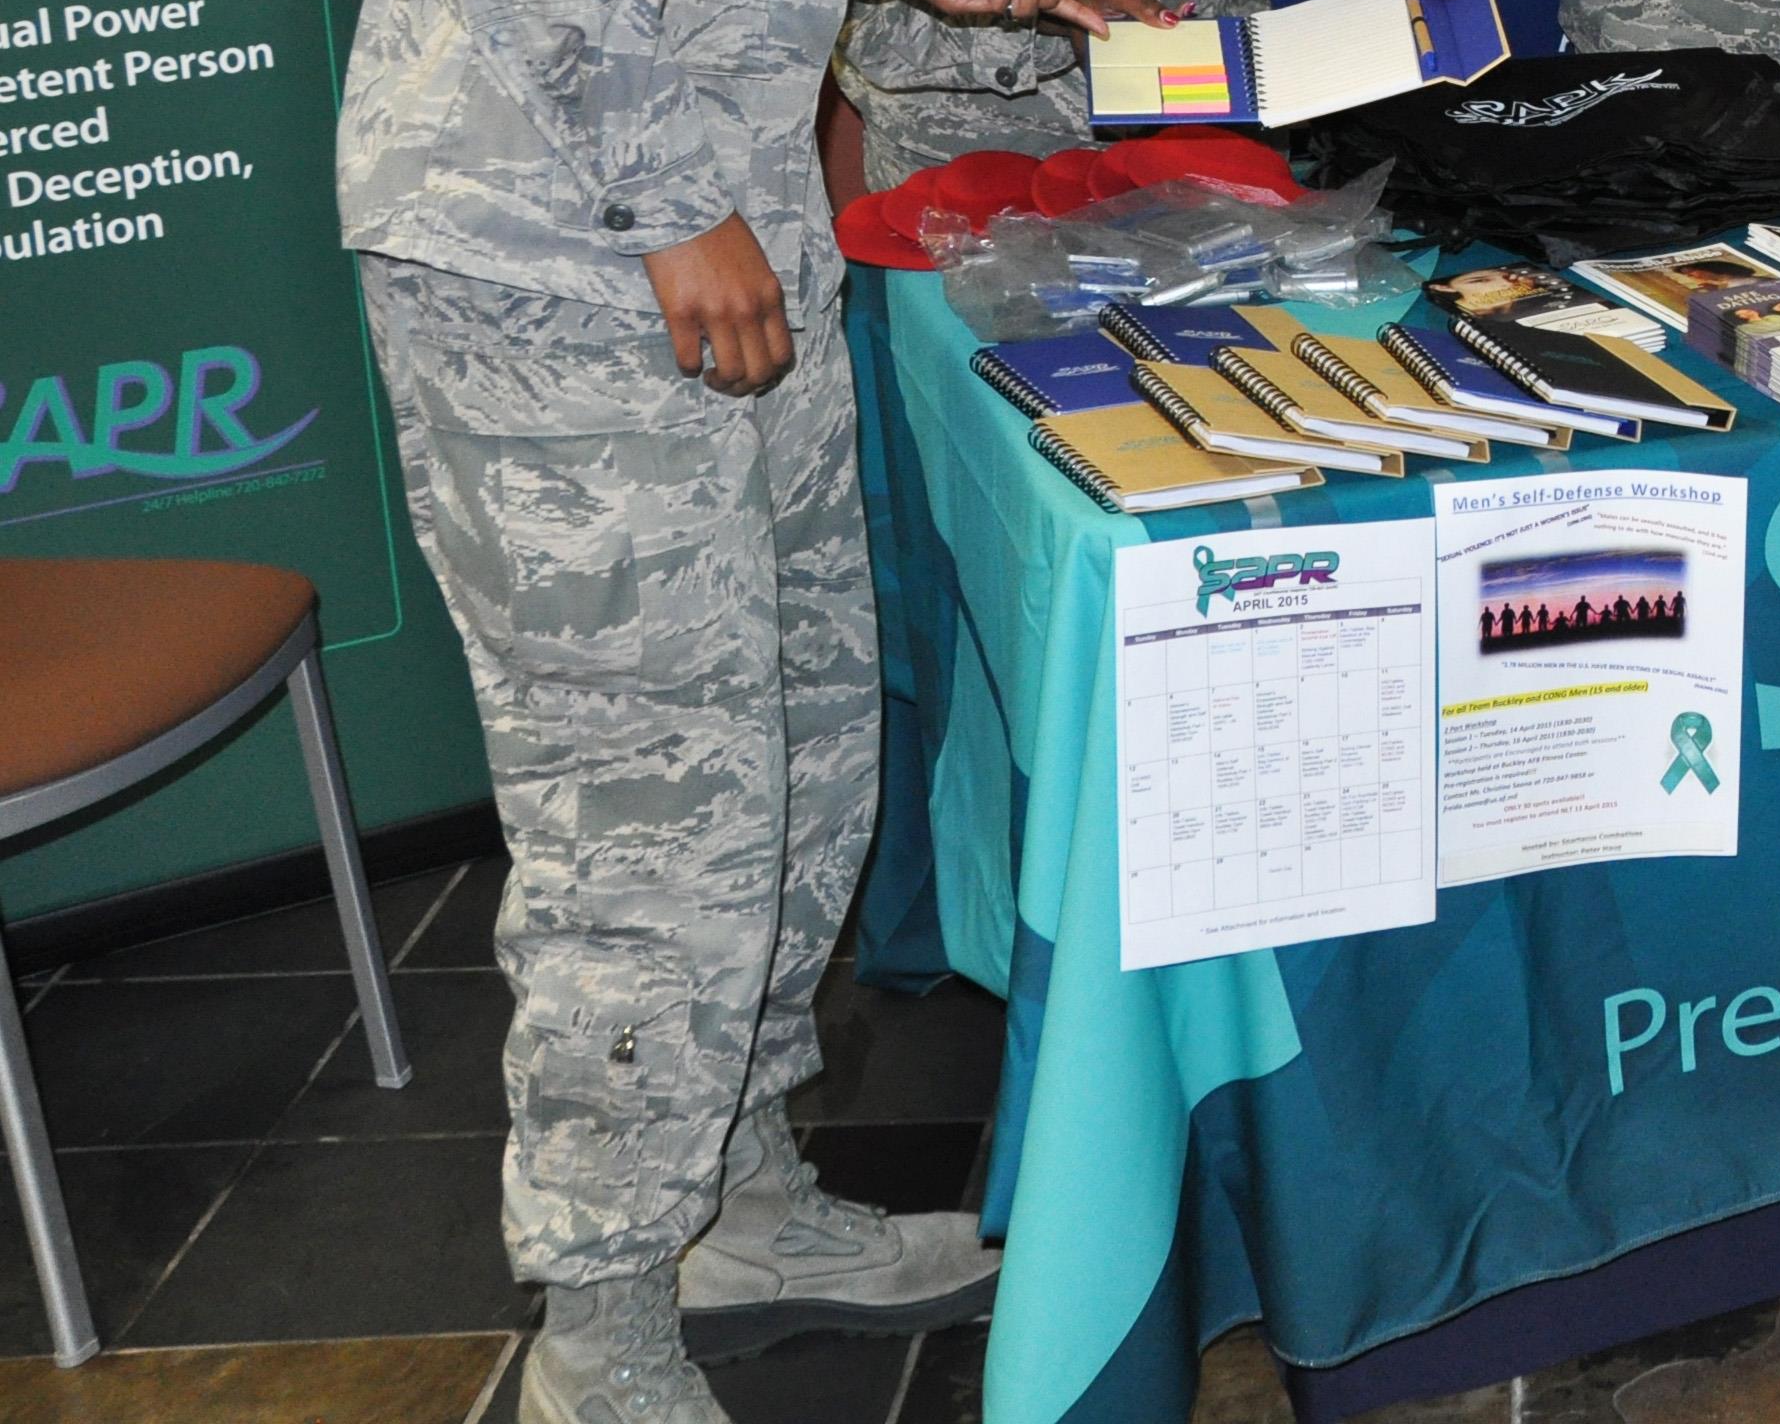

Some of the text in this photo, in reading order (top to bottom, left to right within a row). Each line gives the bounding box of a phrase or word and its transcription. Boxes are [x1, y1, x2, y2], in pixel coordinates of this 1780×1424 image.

[66, 0, 205, 44] Power
[0, 42, 274, 104] etent Person
[9, 147, 253, 208] Deception,
[0, 212, 164, 261] ulation
[0, 345, 270, 493] APR
[175, 486, 232, 506] Helpline
[1513, 486, 1623, 505] Self-Defense
[1632, 483, 1722, 503] Workshop
[1233, 594, 1309, 613] APRIL 2015
[1468, 701, 1490, 713] Team
[1492, 695, 1525, 710] Buckley
[1526, 694, 1542, 704] and
[1543, 690, 1567, 702] CONG
[1569, 688, 1588, 699] Men
[1604, 683, 1622, 693] and
[1623, 681, 1648, 693] older)
